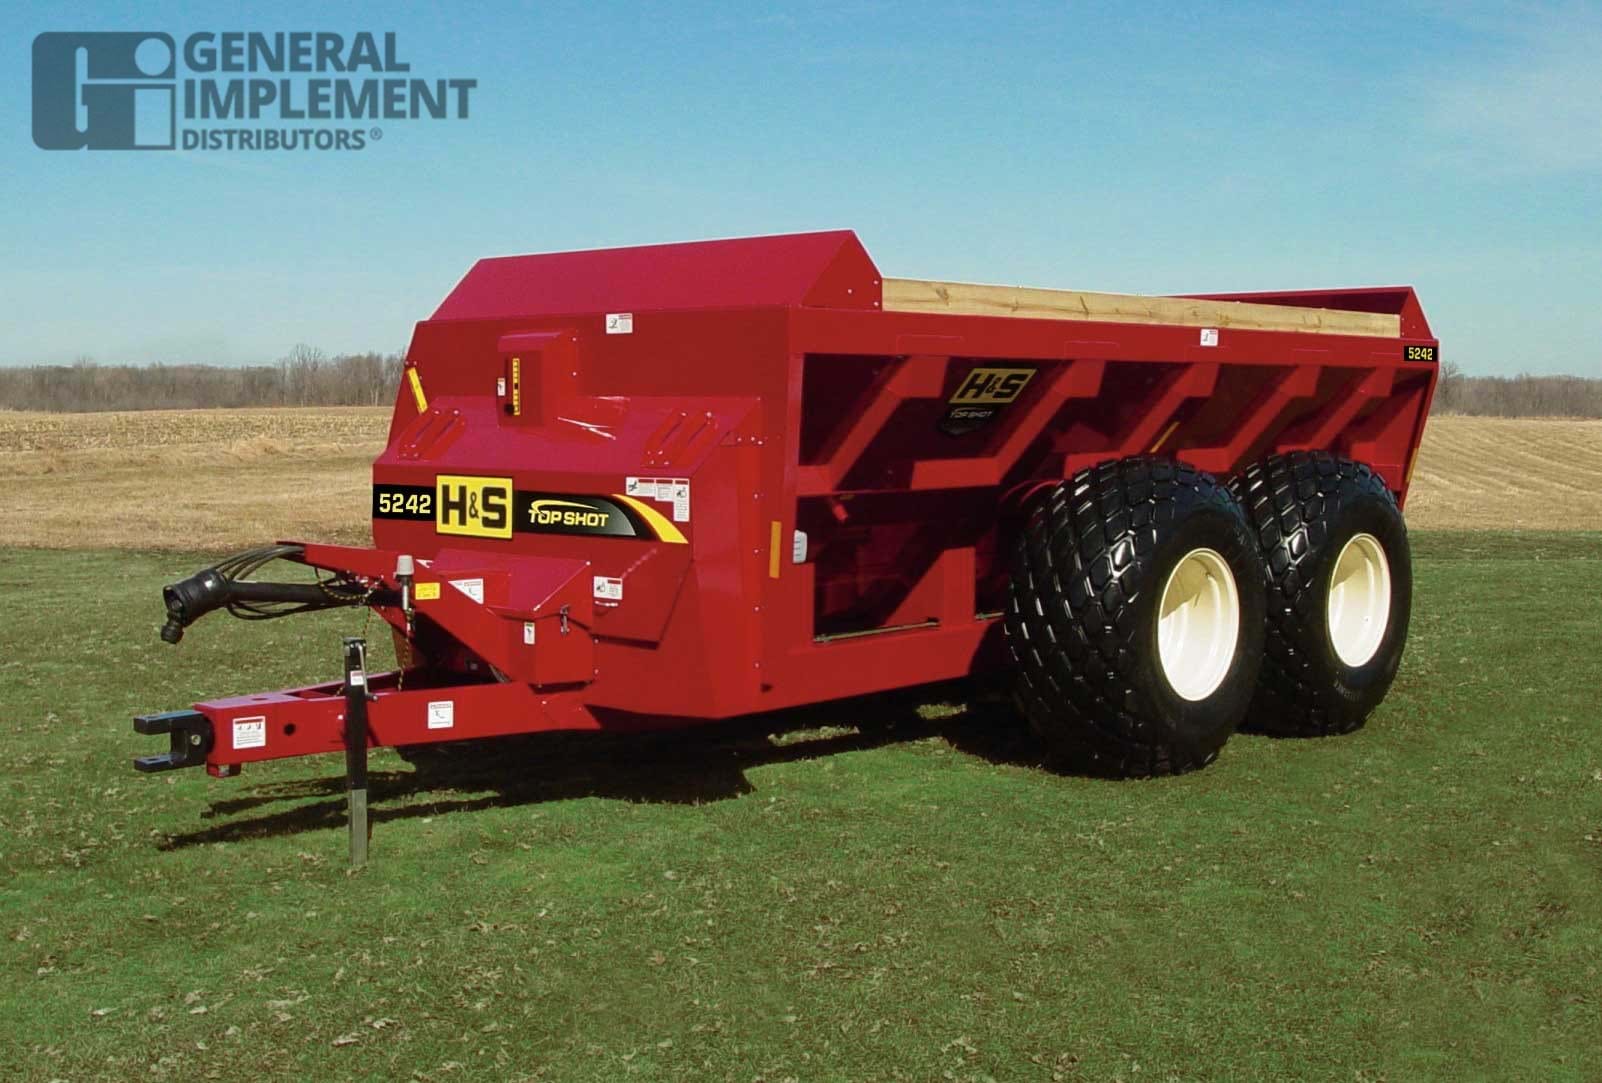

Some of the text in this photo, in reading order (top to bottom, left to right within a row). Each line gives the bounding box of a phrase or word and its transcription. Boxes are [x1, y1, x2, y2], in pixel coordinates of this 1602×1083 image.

[1408, 347, 1433, 361] 5242
[956, 373, 1028, 399] H&S
[379, 493, 431, 514] 5242
[441, 484, 507, 530] H&S
